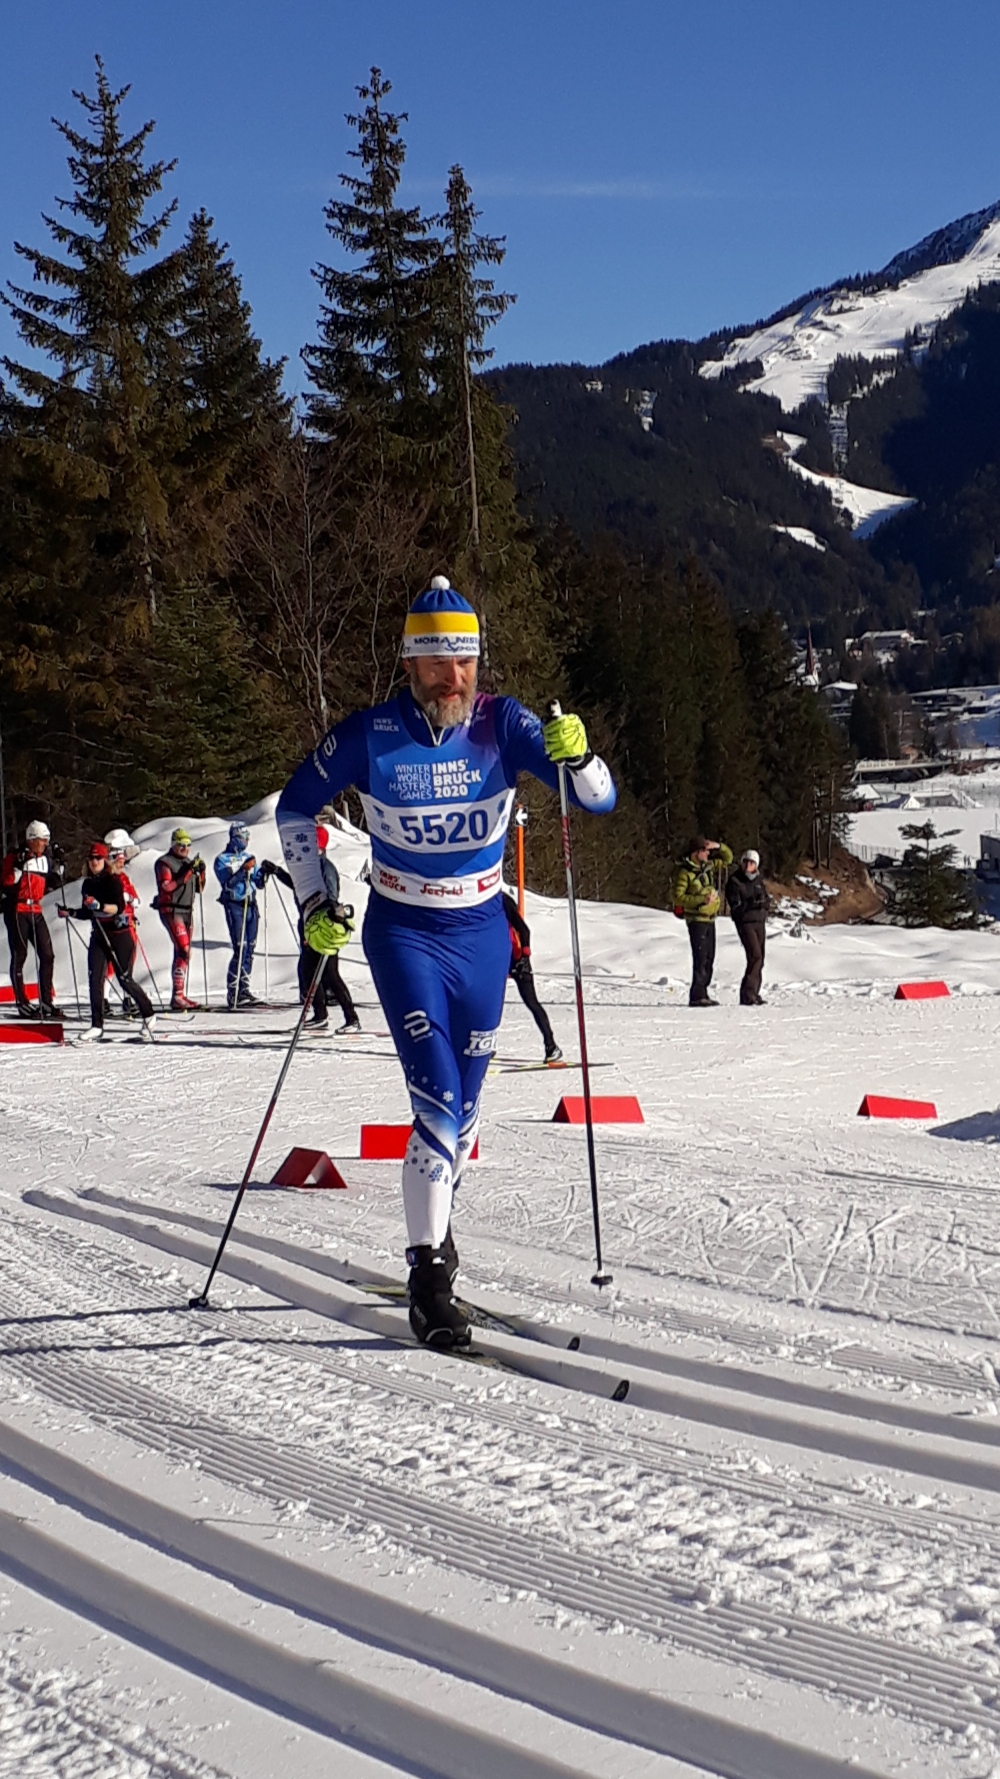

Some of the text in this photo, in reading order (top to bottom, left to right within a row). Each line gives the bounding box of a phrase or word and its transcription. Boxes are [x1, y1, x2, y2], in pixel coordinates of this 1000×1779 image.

[394, 764, 430, 773] WINTER
[432, 758, 469, 774] INNS'
[397, 773, 431, 782] WORLD
[433, 769, 482, 786] BRUCK
[389, 782, 432, 792] MASTERS
[434, 784, 469, 799] 2020
[399, 790, 432, 800] GAMES
[399, 809, 488, 845] 5520
